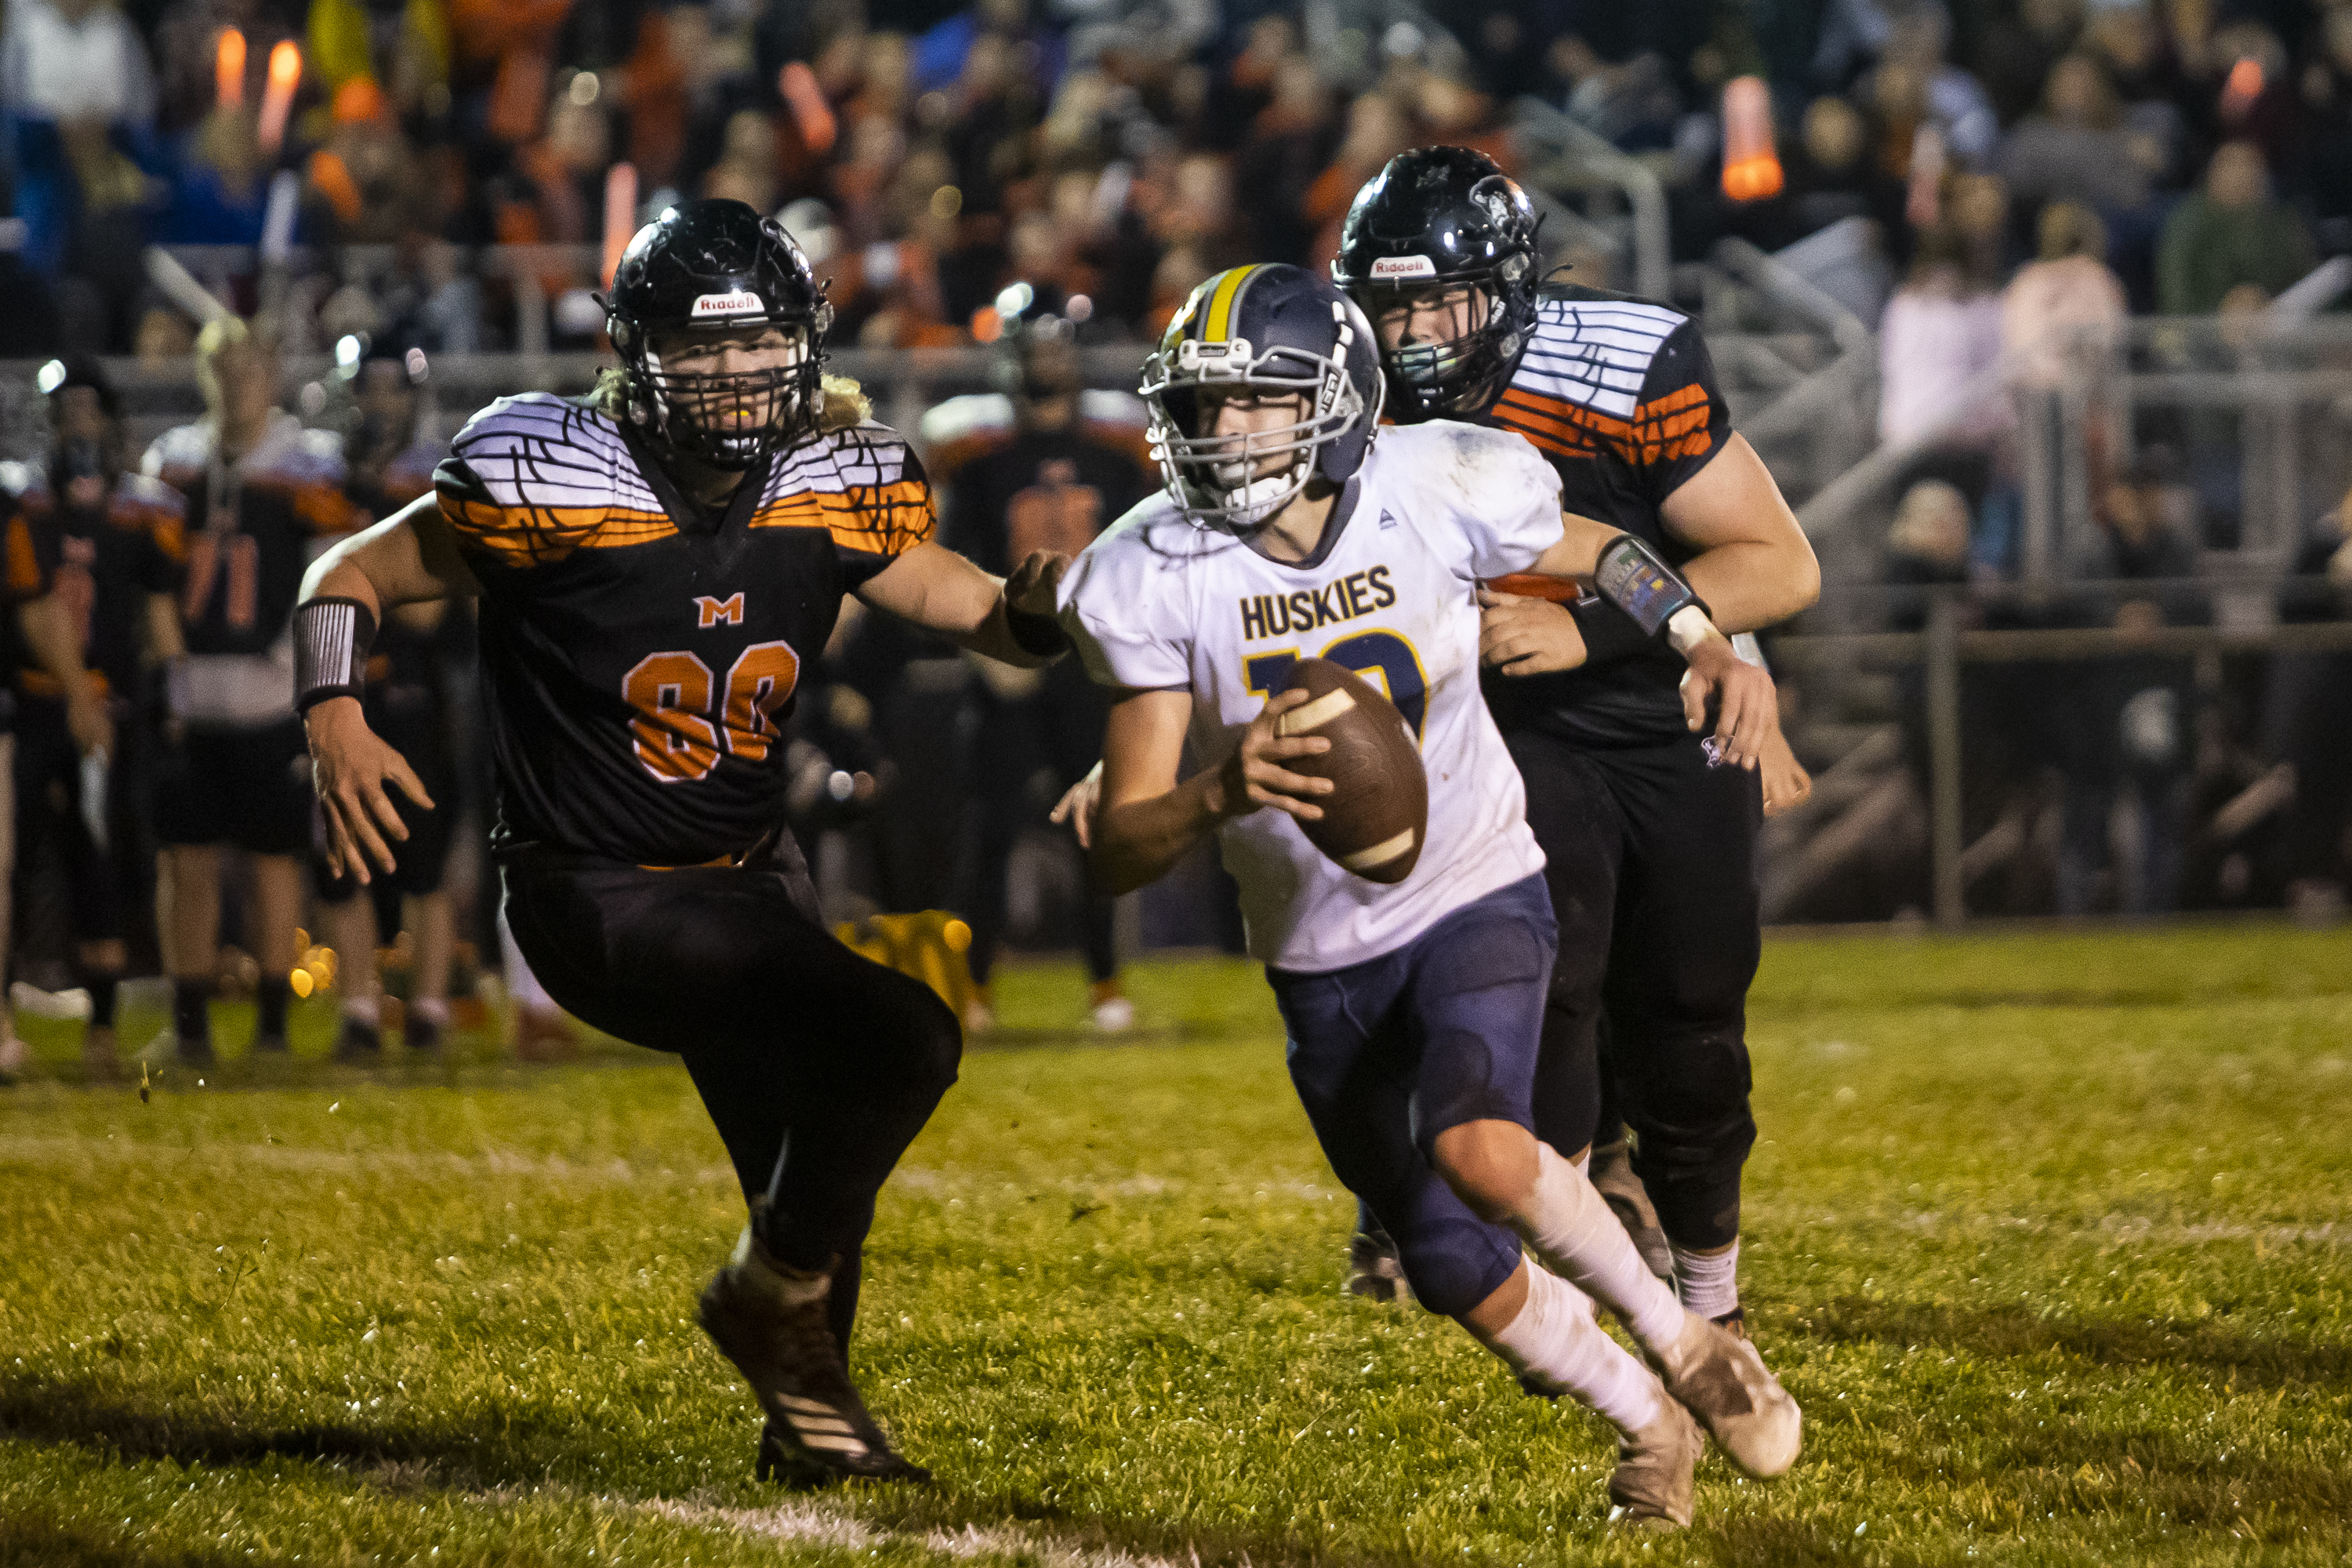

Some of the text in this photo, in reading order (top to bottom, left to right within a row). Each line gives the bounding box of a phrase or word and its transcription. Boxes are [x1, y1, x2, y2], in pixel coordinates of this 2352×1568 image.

[1376, 261, 1424, 273] Riddell
[700, 296, 754, 310] Riddell
[691, 592, 745, 628] M
[1239, 564, 1397, 641] HUSKIES
